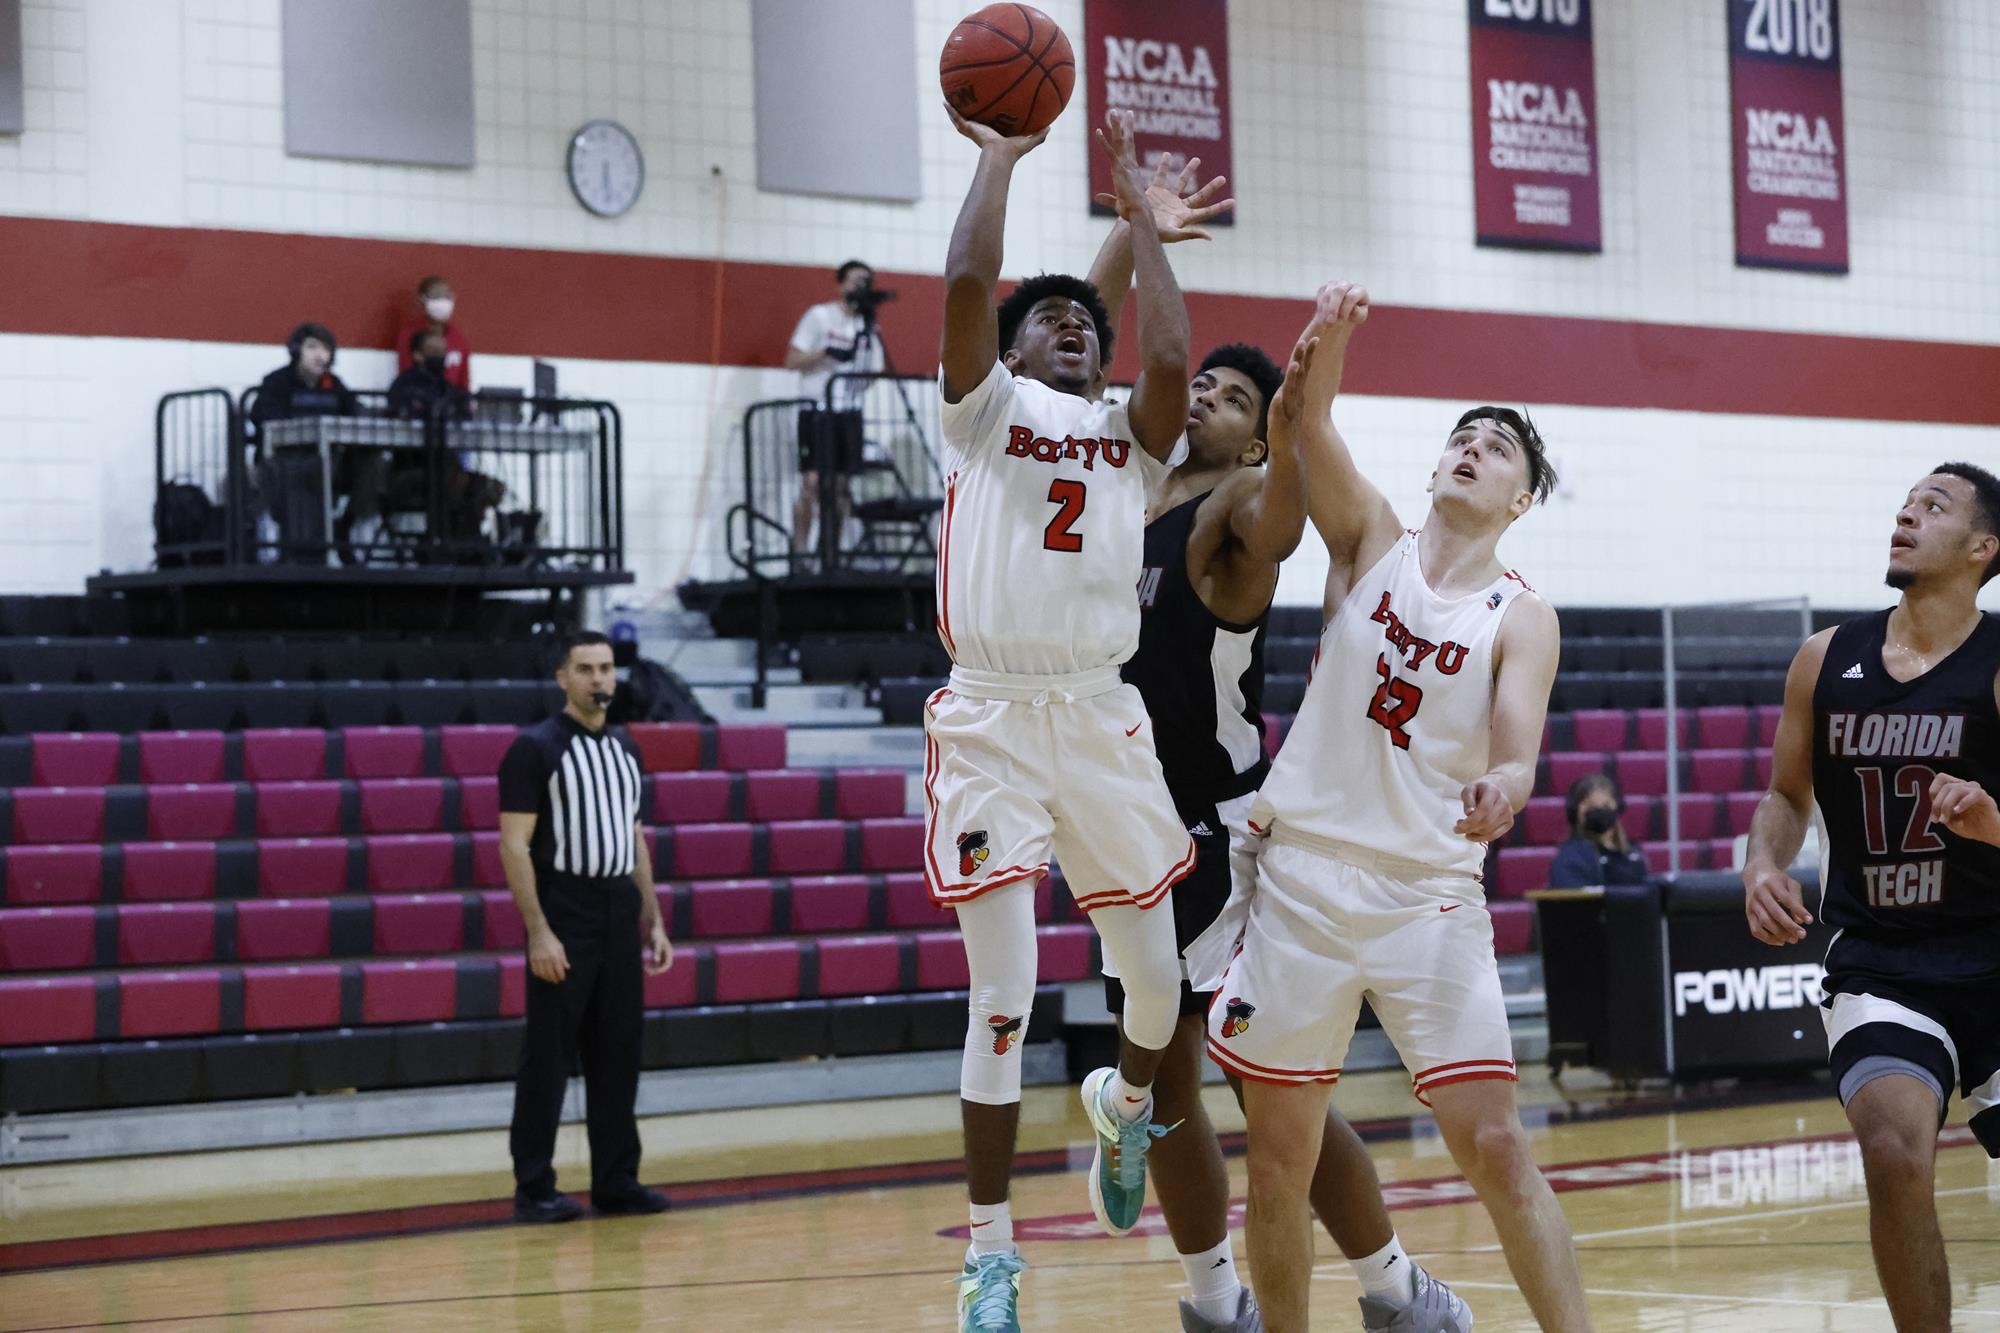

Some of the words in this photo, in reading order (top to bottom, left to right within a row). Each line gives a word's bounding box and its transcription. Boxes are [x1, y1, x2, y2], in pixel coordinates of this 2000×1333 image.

[1745, 0, 1832, 60] 2018
[1104, 35, 1219, 89] NCAA
[1106, 80, 1220, 115] NATIONAL
[1488, 79, 1588, 128] NCAA
[1746, 107, 1838, 155] NCAA
[1489, 145, 1591, 176] CHAMPIONS
[1043, 478, 1087, 553] 2
[1827, 712, 1966, 759] FLORIDA
[1854, 764, 1946, 855] 12
[1862, 860, 1944, 907] TECH
[1674, 963, 1826, 1017] POWER
